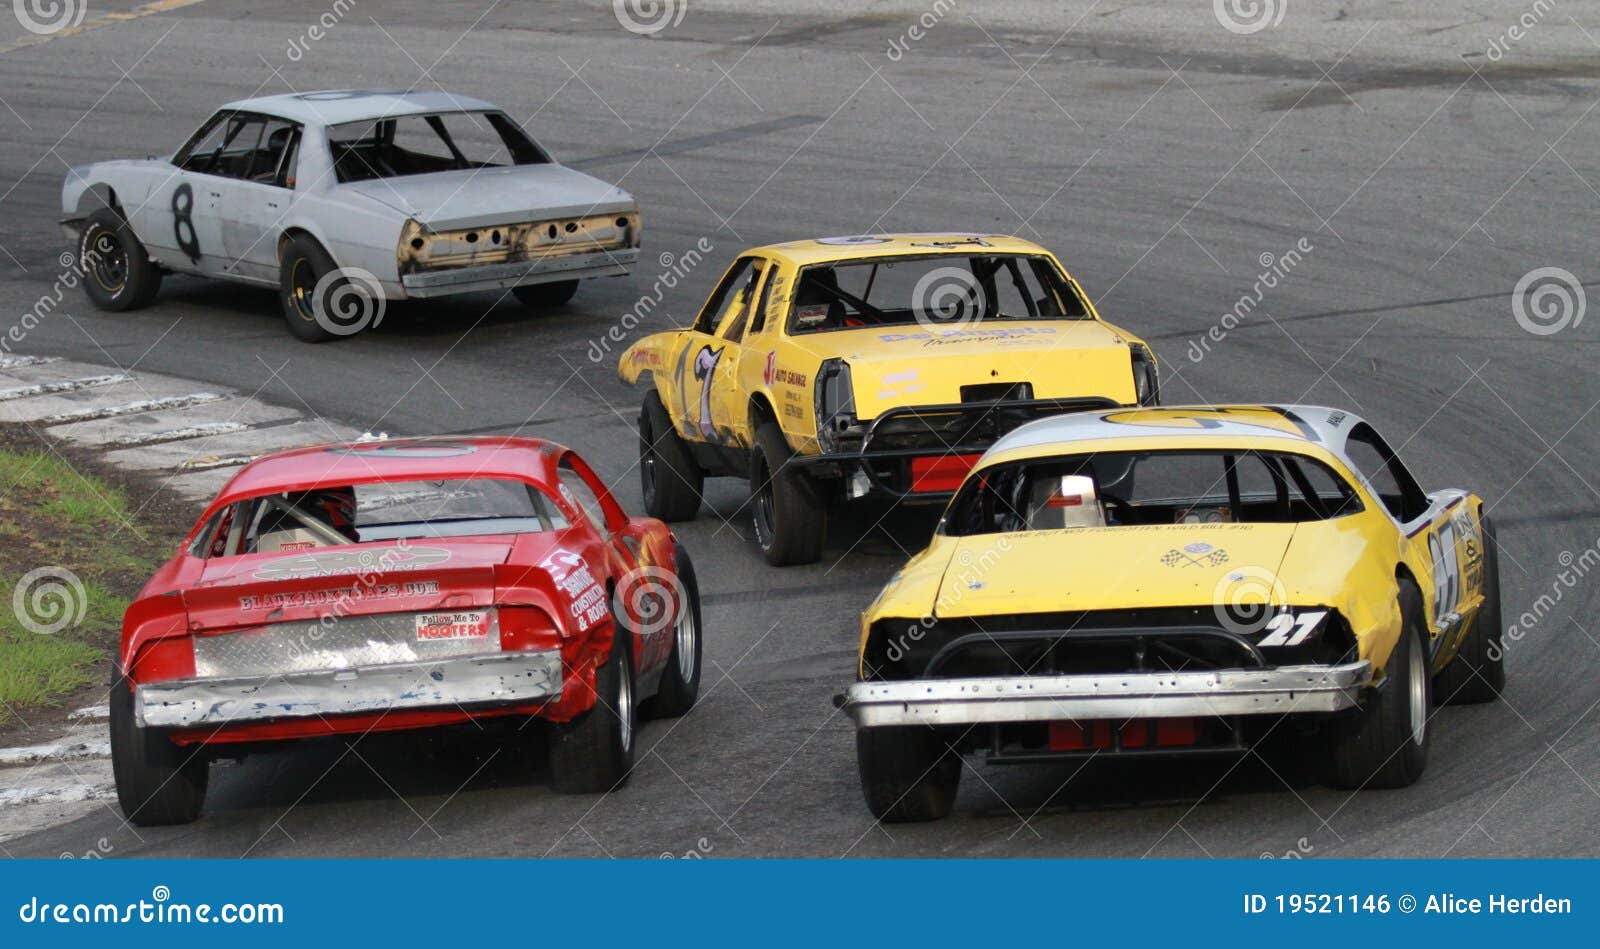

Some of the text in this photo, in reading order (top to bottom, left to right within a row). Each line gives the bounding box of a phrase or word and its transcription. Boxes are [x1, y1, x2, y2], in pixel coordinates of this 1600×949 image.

[172, 183, 200, 266] 8
[469, 613, 480, 622] To
[1256, 612, 1328, 647] 27
[417, 623, 487, 638] HOOTERS
